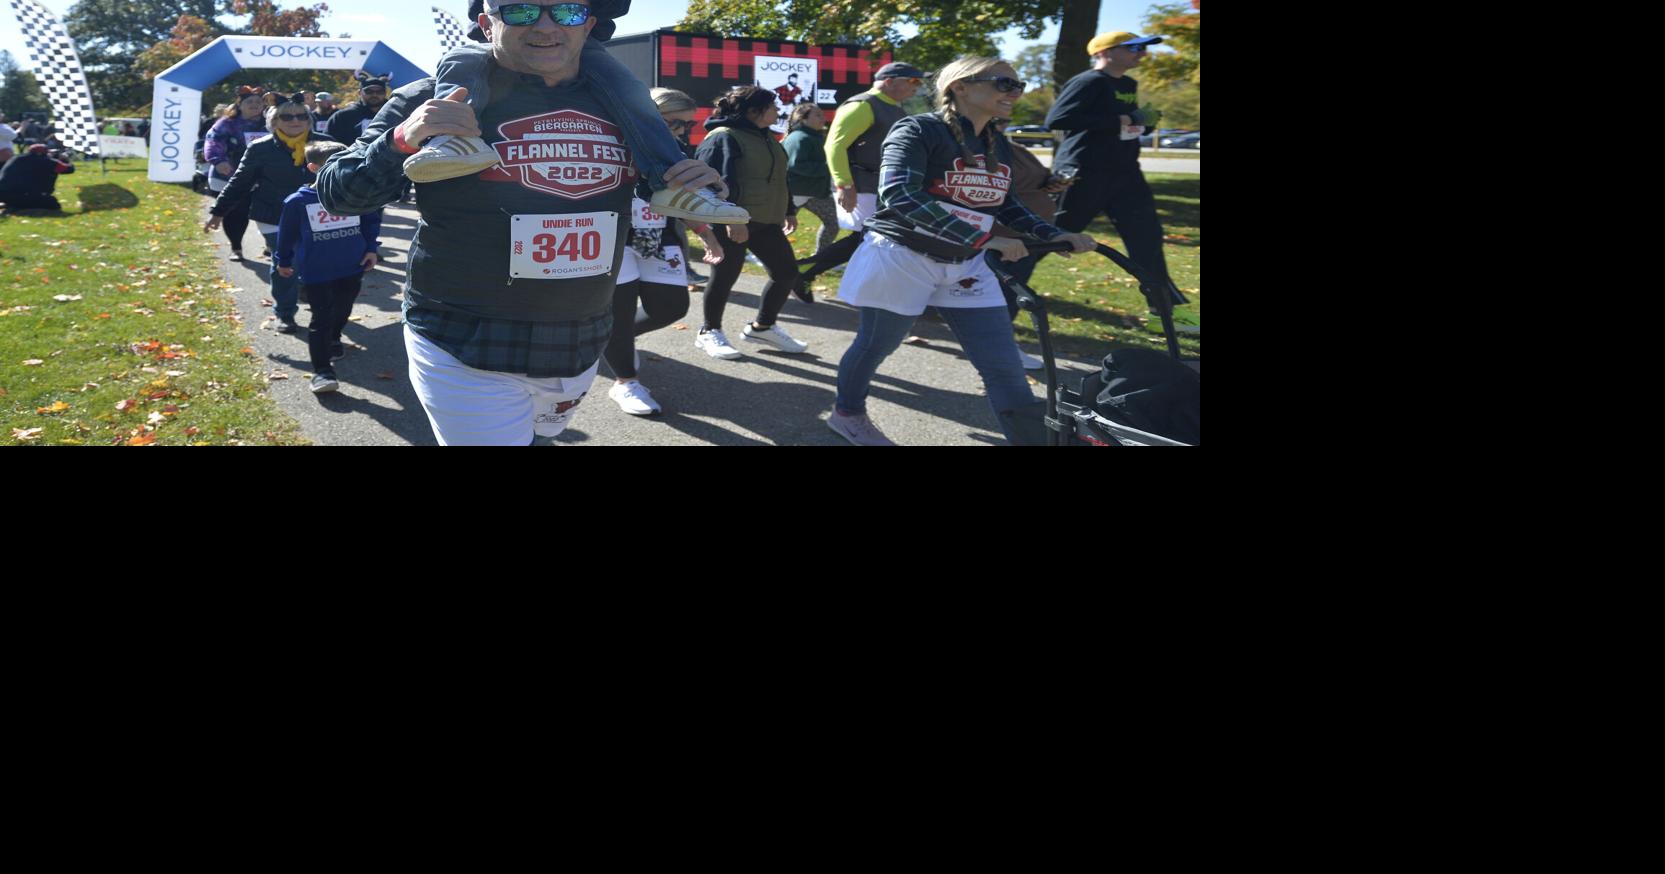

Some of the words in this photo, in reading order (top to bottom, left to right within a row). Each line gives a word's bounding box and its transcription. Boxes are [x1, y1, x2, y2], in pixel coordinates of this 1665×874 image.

[250, 45, 352, 58] JOCKEY
[761, 61, 812, 72] JOCKEY
[534, 121, 603, 134] BIERGARTEN
[161, 99, 182, 171] JOCKEY
[507, 144, 588, 161] FLANNEL
[593, 144, 627, 162] FEST
[547, 166, 603, 180] 2022
[967, 190, 996, 199] 2022
[542, 219, 573, 229] UNDIE
[575, 218, 594, 227] RUN
[313, 226, 361, 242] Reebok
[532, 230, 602, 264] 340
